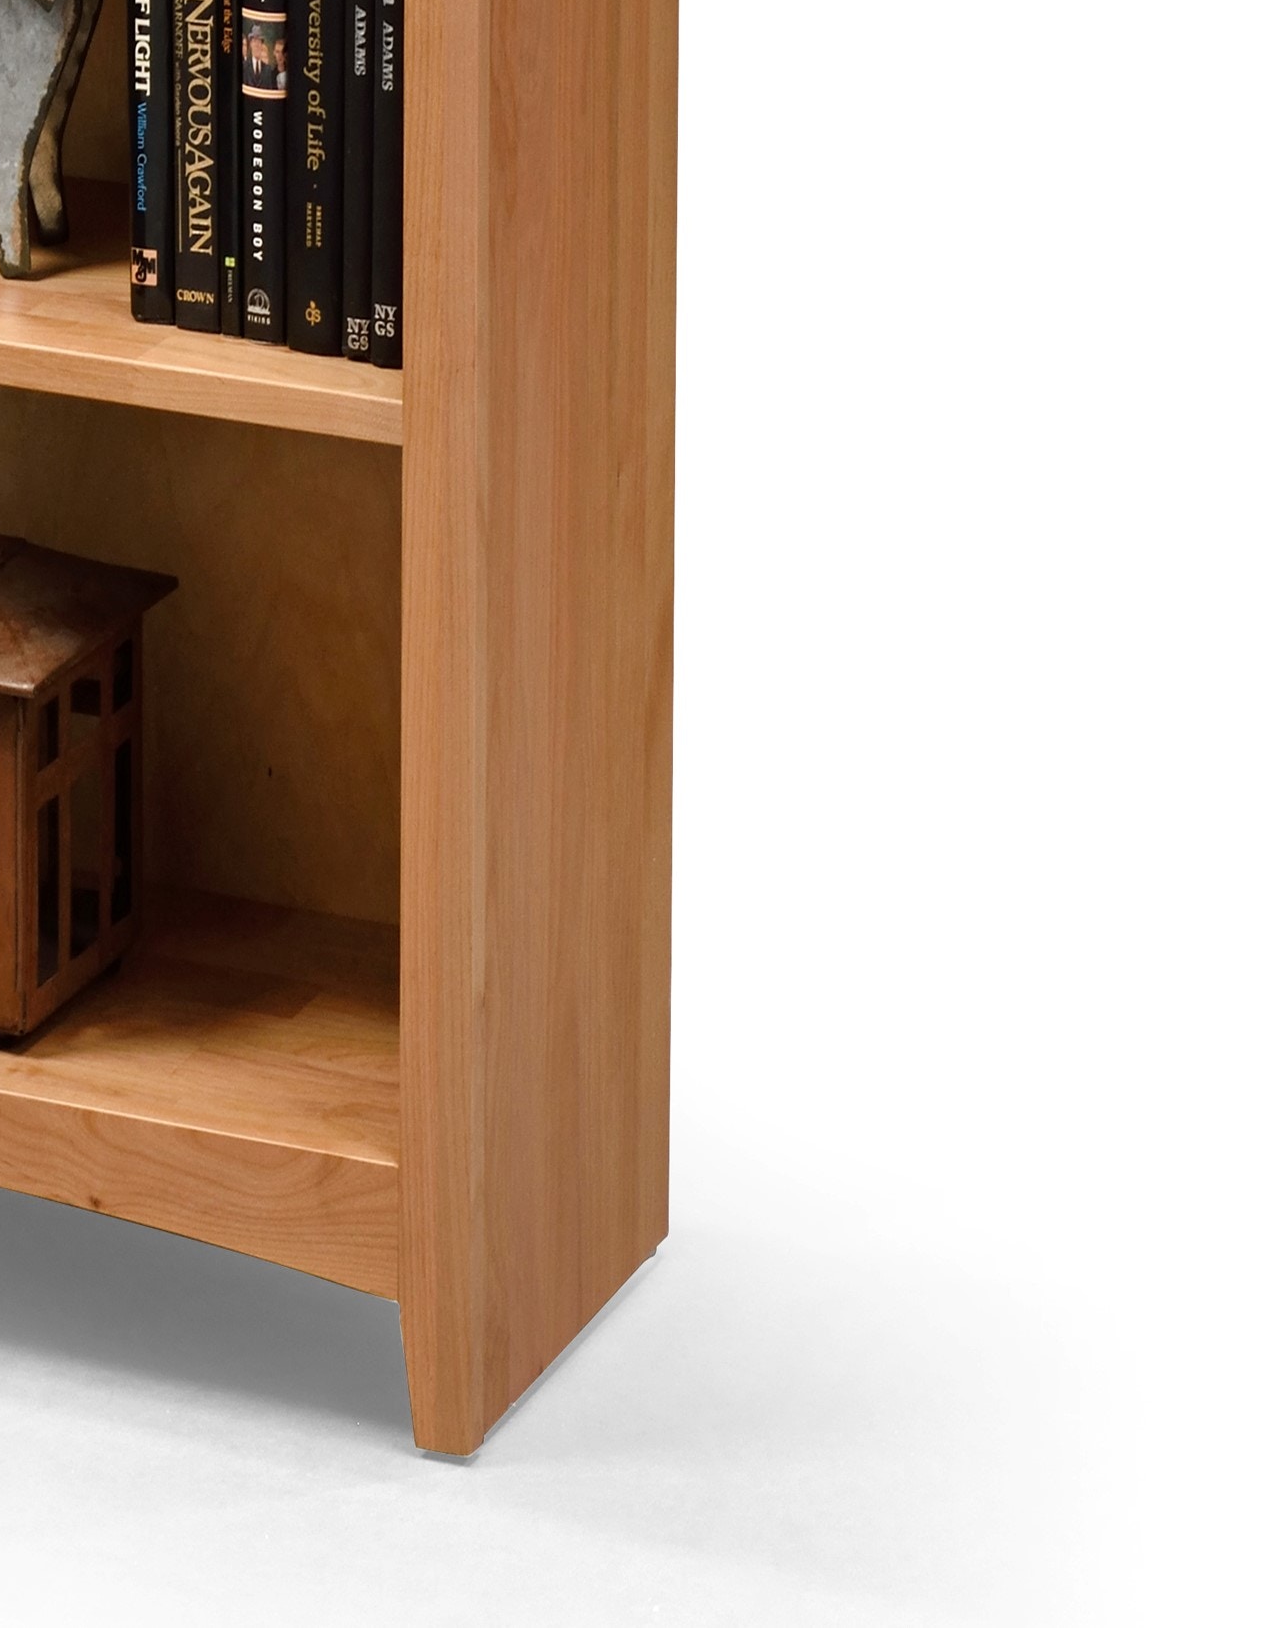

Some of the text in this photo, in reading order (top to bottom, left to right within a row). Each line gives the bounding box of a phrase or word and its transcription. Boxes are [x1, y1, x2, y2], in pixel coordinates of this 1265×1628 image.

[223, 8, 233, 25] the
[221, 26, 234, 55] Edge
[354, 4, 367, 76] ADAMS
[134, 17, 151, 97] LIGHT
[381, 19, 394, 92] ADAMS
[307, 89, 326, 119] of
[136, 101, 148, 212] William Crawford
[306, 122, 326, 172] Life
[185, 142, 215, 256] AGAIN
[252, 111, 264, 262] WOBEGON BOY
[176, 288, 215, 305] CROWN
[247, 315, 271, 326] VIKING
[347, 317, 370, 335] NY
[374, 303, 397, 322] NY
[347, 334, 369, 351] GS
[374, 320, 396, 337] GS
